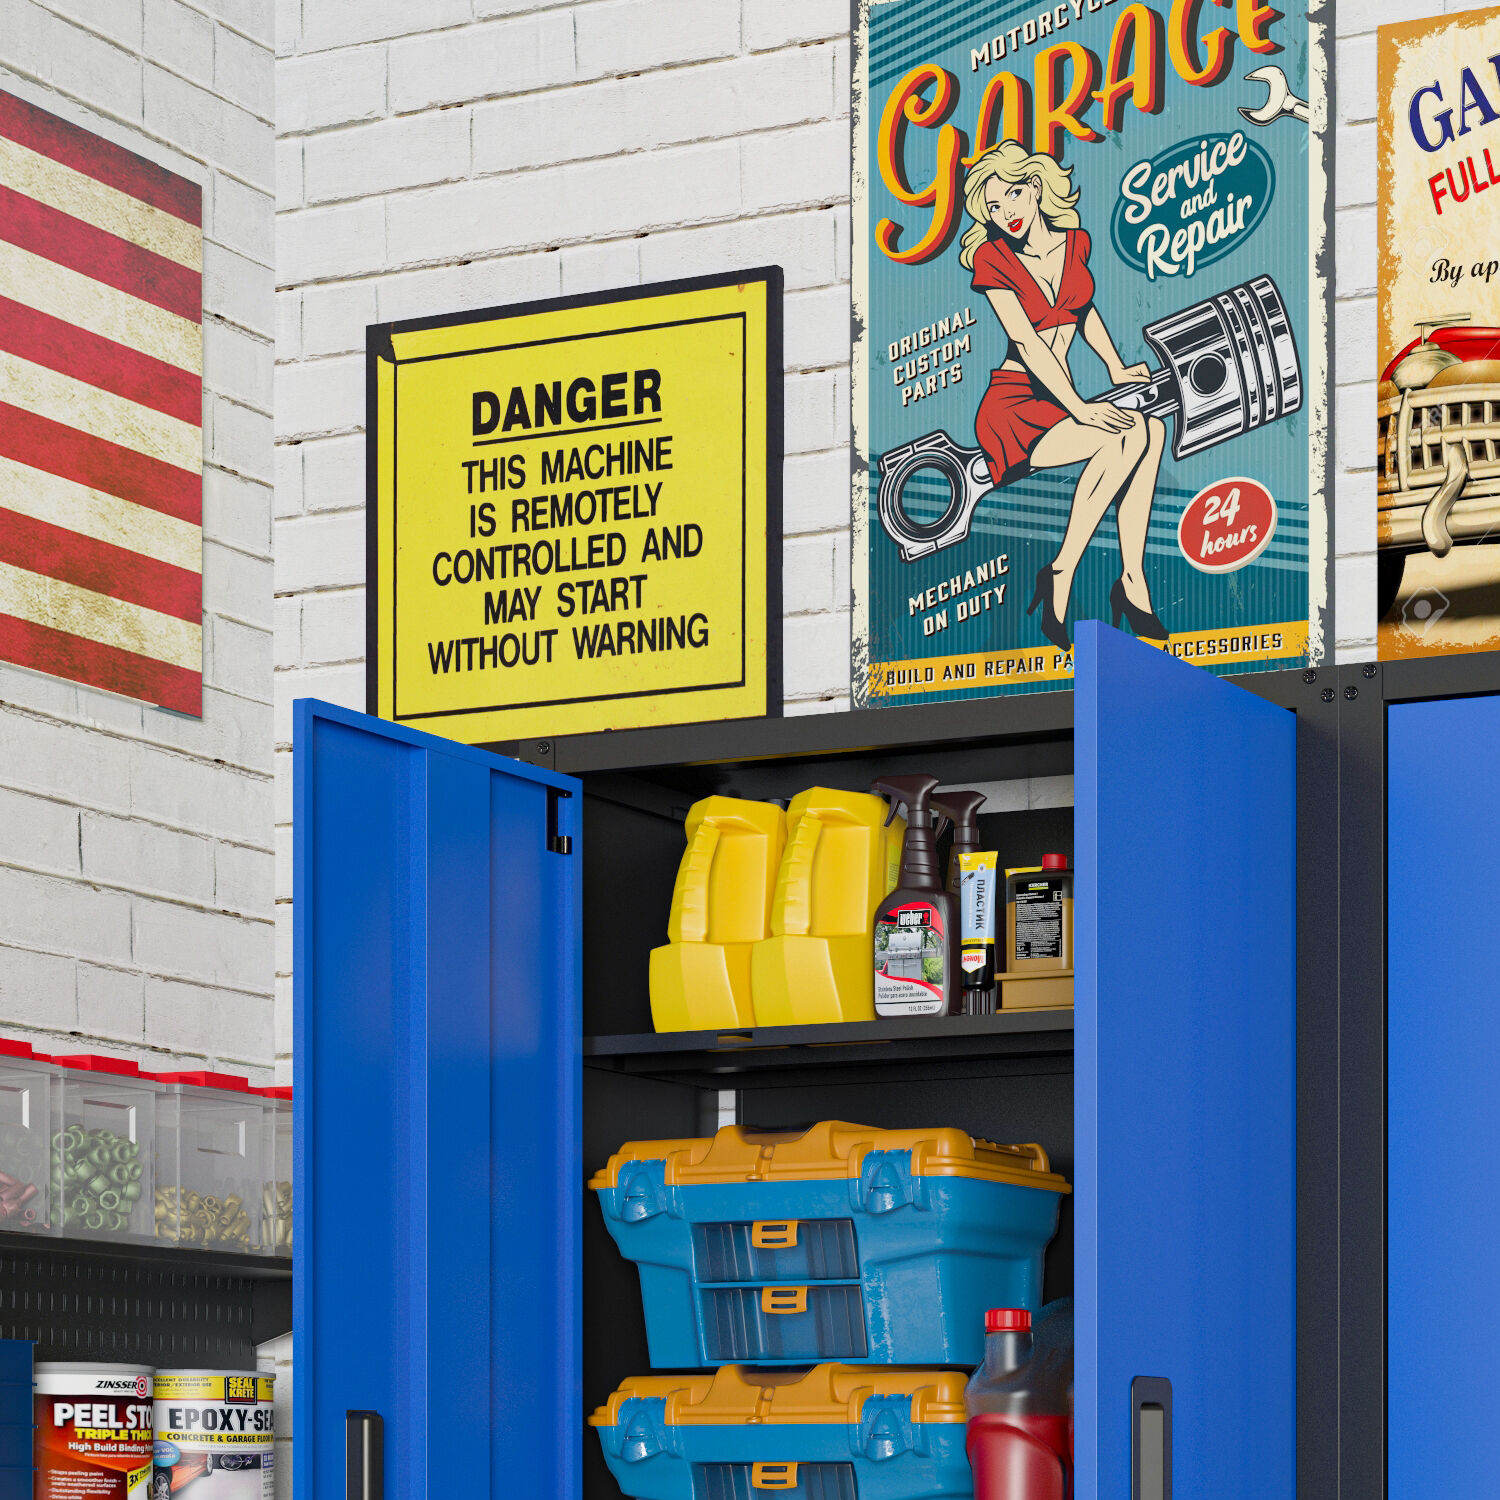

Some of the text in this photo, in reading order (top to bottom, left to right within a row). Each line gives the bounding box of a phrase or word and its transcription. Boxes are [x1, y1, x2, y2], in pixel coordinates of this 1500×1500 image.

[970, 0, 1122, 72] MOTORCYC
[875, 0, 1286, 266] GARAGE
[1122, 131, 1247, 225] Service
[1180, 184, 1217, 220] and
[1136, 194, 1252, 279] Repair
[1429, 258, 1464, 288] By
[888, 307, 977, 362] ORIGINAL
[893, 334, 971, 385] CUSTOM
[472, 368, 662, 436] DANGER
[902, 364, 963, 406] PARTS
[462, 436, 673, 494] THIS MACHINE
[470, 482, 664, 538] IS REMOTELY
[1202, 488, 1242, 527] 24
[433, 523, 703, 586] CONTROLLED AND
[1199, 521, 1259, 559] hours
[484, 575, 648, 624] MAY START
[908, 553, 1010, 617] MECHANIC
[923, 584, 1008, 637] ON DUTY
[428, 612, 709, 674] WITHOUT WARNING
[887, 667, 934, 686] BUILD
[943, 663, 976, 681] AND
[985, 656, 1044, 676] REPAIR
[900, 911, 922, 925] weber
[975, 879, 985, 930] ПЛАСТИК
[96, 1380, 137, 1389] ZINSSER
[229, 1378, 254, 1389] SEAL
[229, 1389, 254, 1398] KRETE
[54, 1403, 153, 1429] PEEL STO
[74, 1428, 128, 1439] TRIPLE
[167, 1433, 214, 1442] CONCRETE
[227, 1435, 255, 1443] GARAGE
[169, 1408, 273, 1431] EPOXY-SEA
[68, 1442, 91, 1452] High
[94, 1443, 117, 1451] Build
[119, 1444, 144, 1454] Binding
